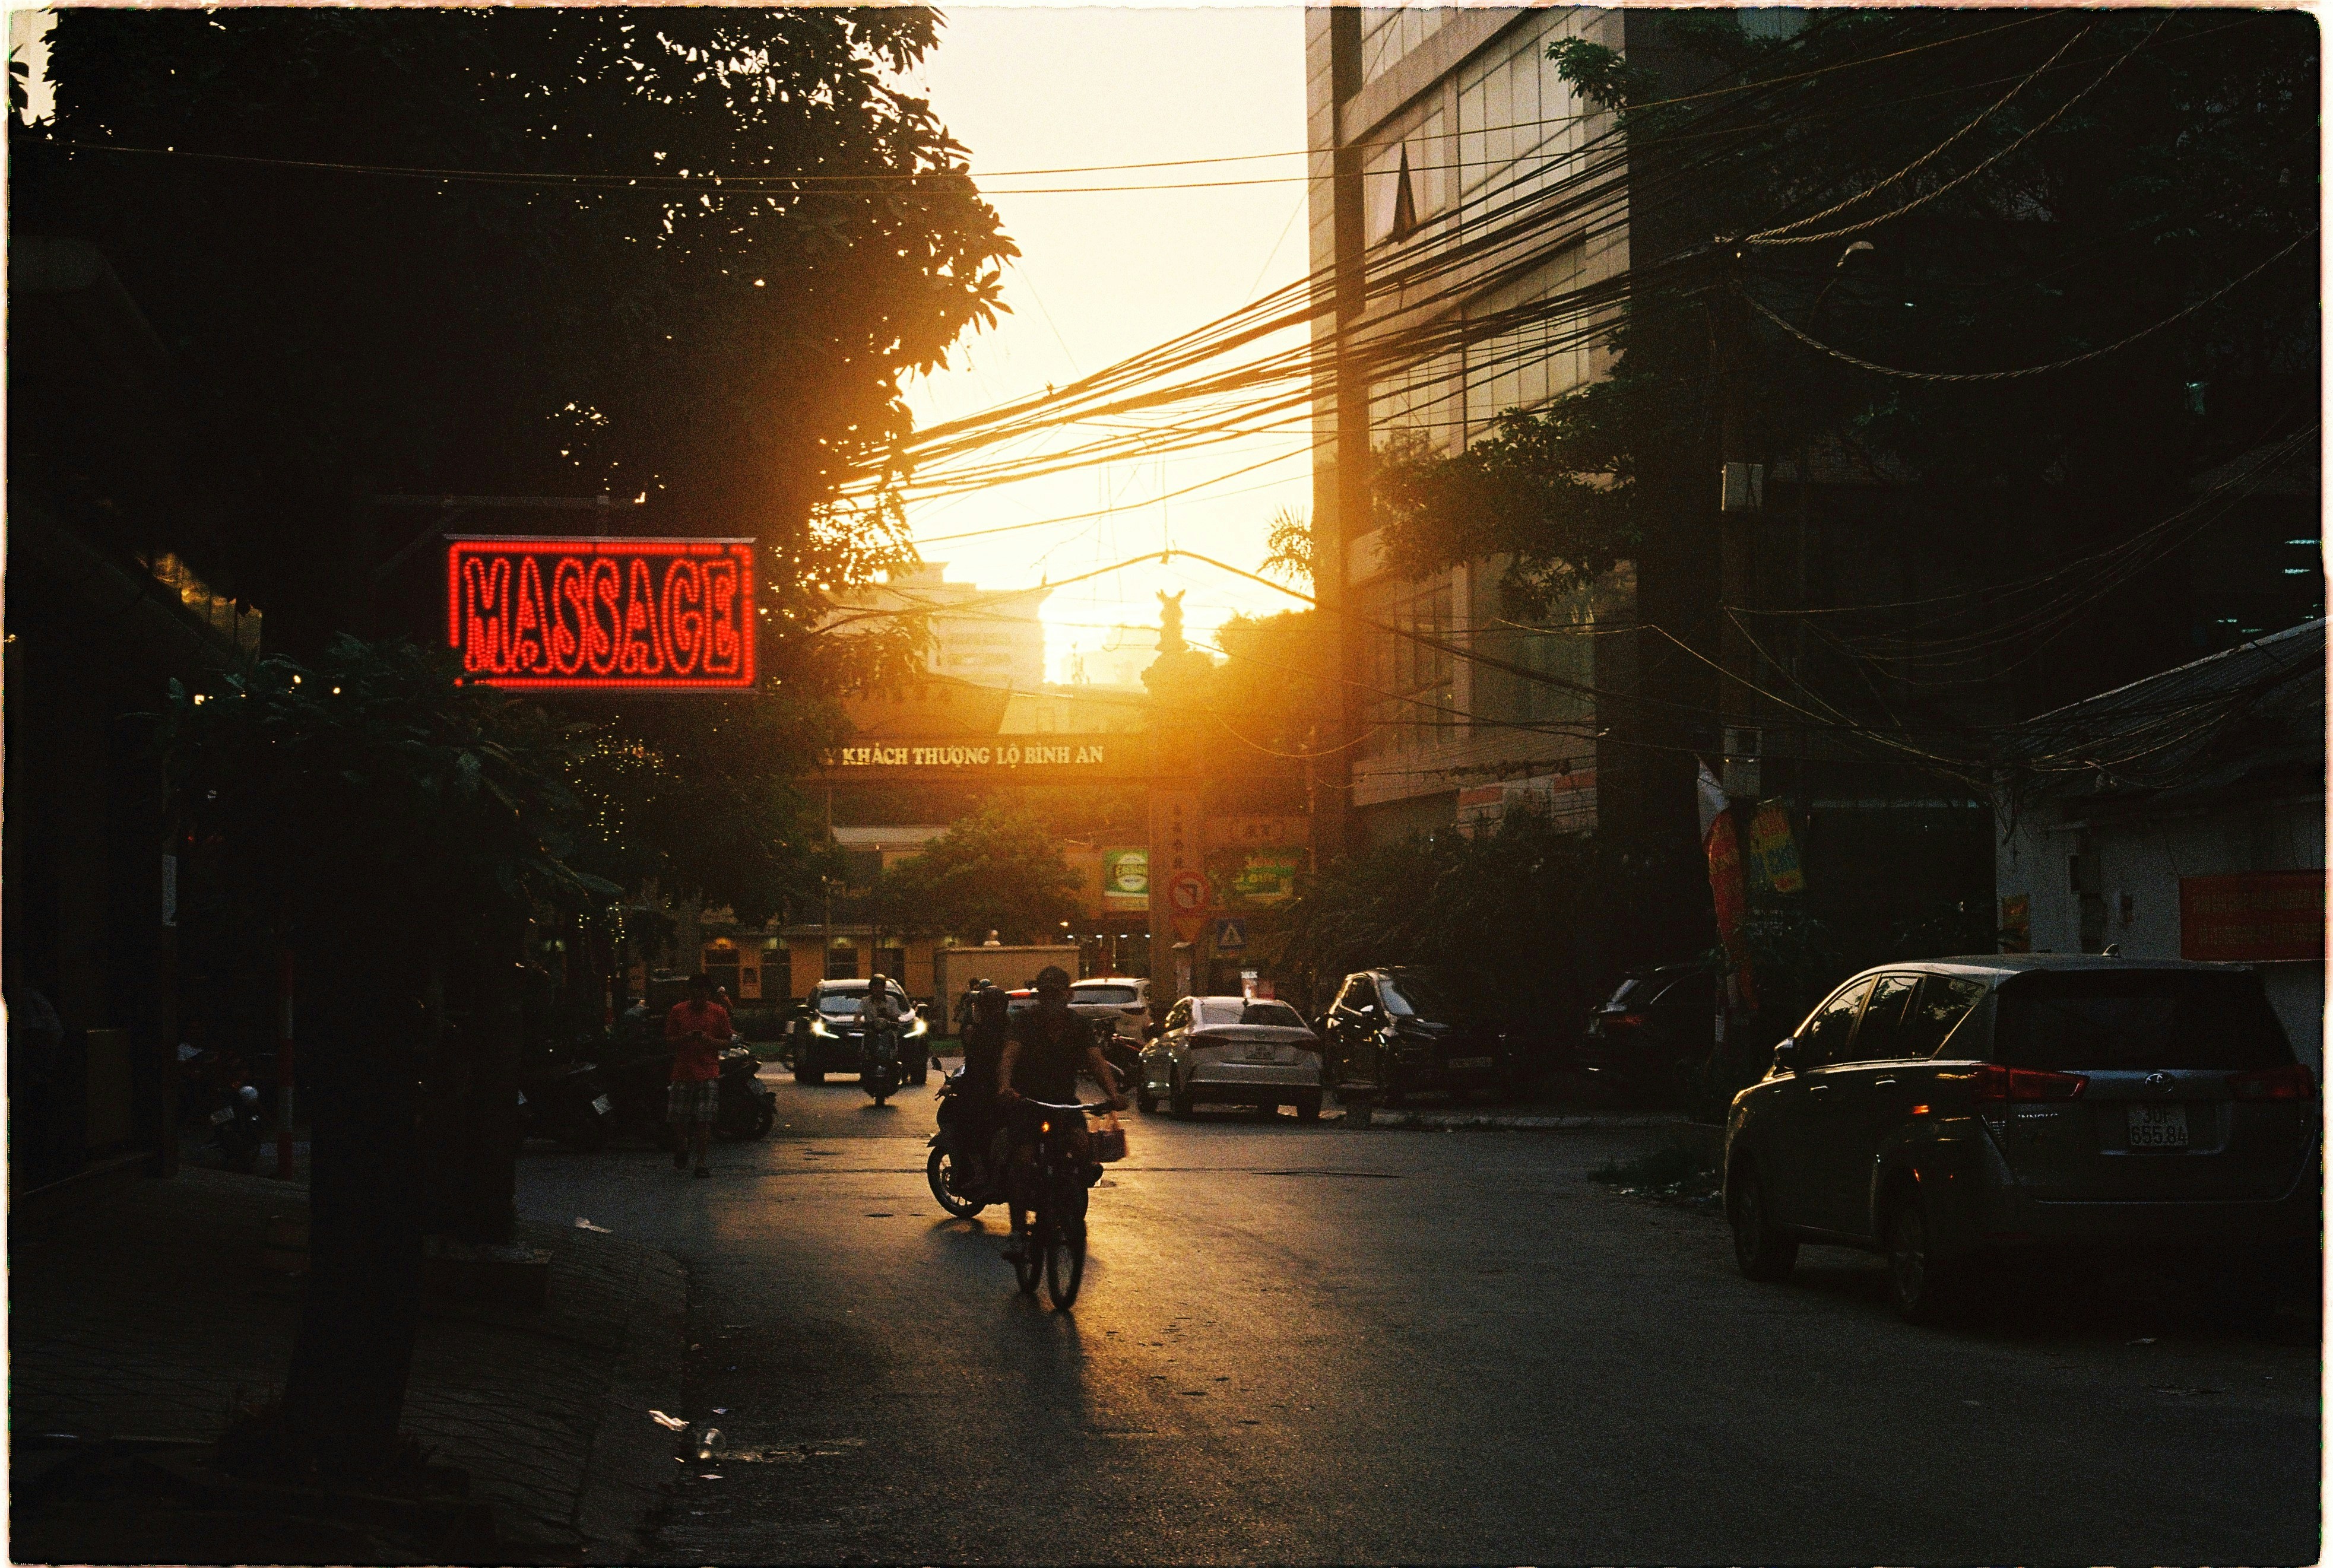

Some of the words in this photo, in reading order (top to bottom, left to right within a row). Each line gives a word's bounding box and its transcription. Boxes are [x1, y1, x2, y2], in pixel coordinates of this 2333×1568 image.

[463, 556, 740, 675] MASSAGE
[912, 745, 990, 767] THƯỢNG
[996, 742, 1020, 768] LỘ
[1025, 742, 1070, 764] BÌNH
[1075, 745, 1104, 764] AN
